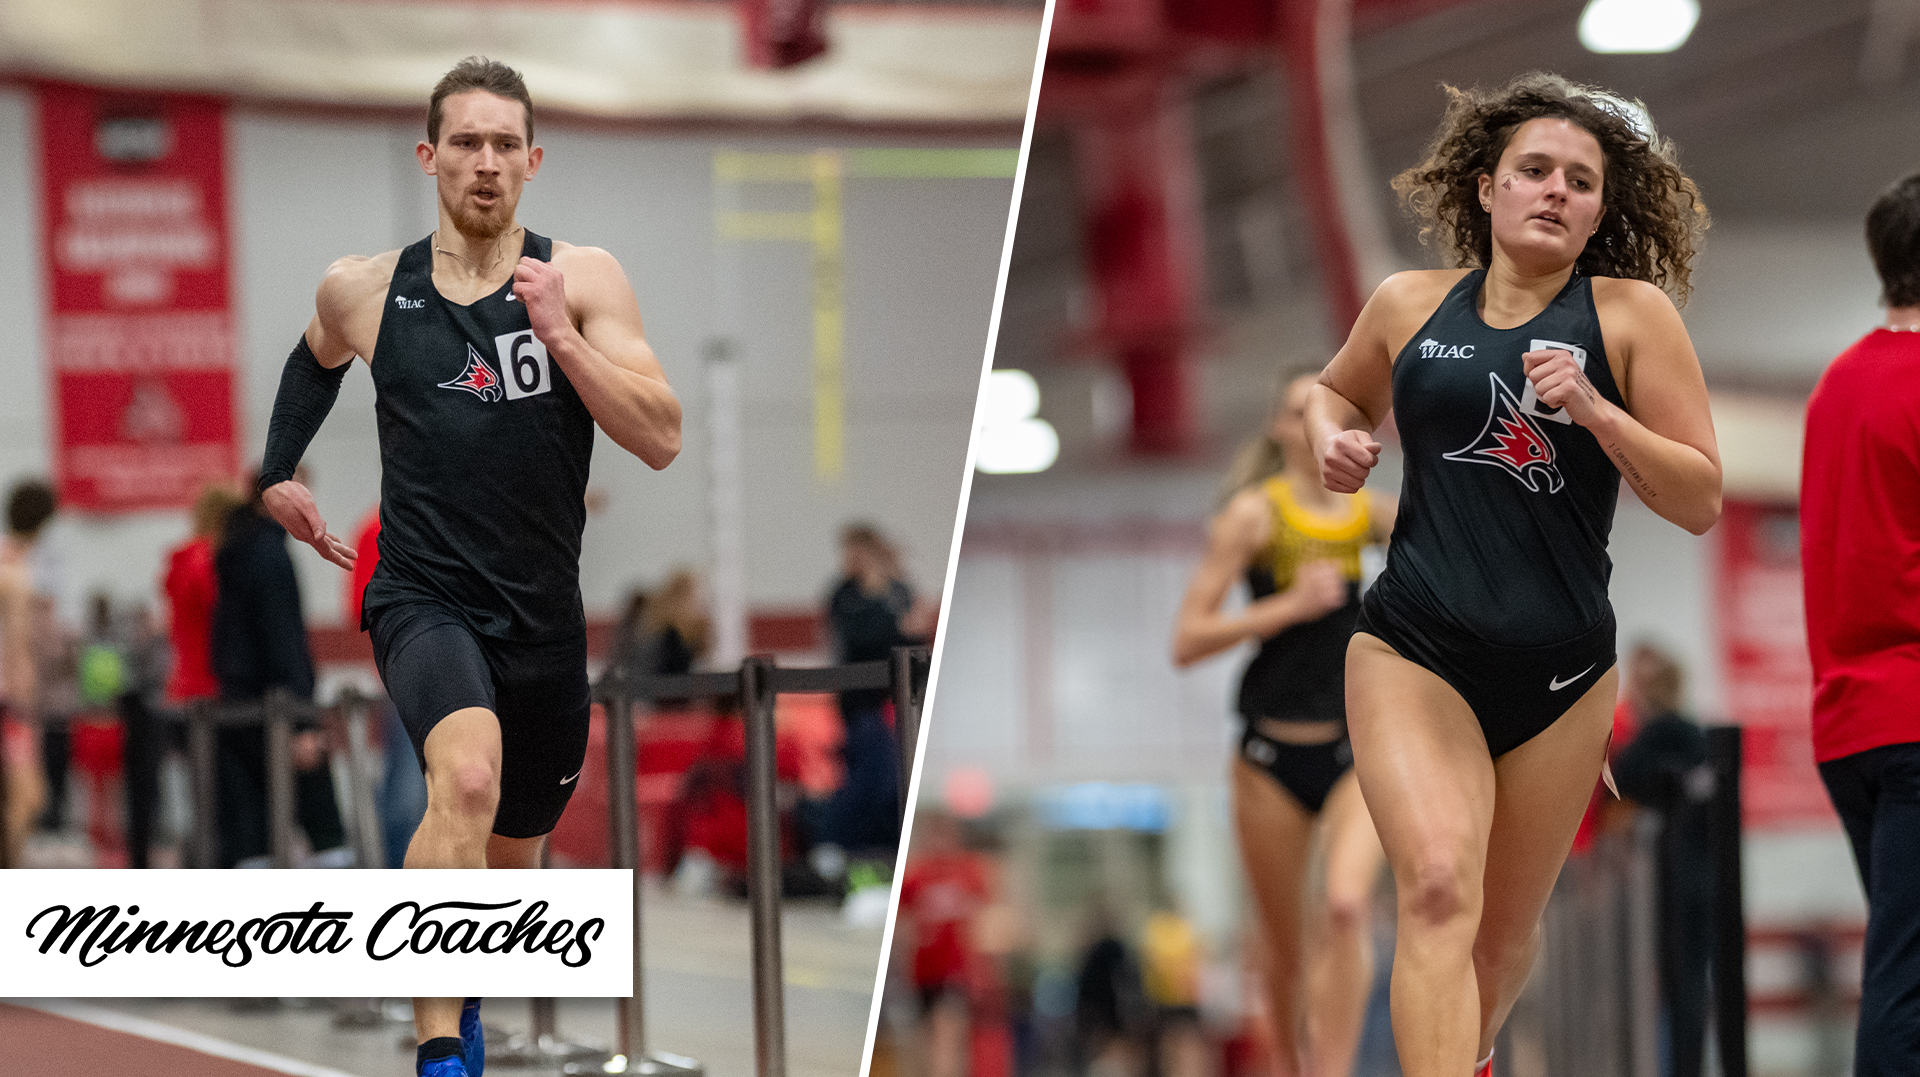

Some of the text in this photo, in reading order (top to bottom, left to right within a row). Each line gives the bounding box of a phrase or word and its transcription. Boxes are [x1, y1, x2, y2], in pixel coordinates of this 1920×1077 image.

[397, 298, 425, 309] WIAC
[1420, 344, 1475, 359] WIAC
[510, 334, 541, 393] 6
